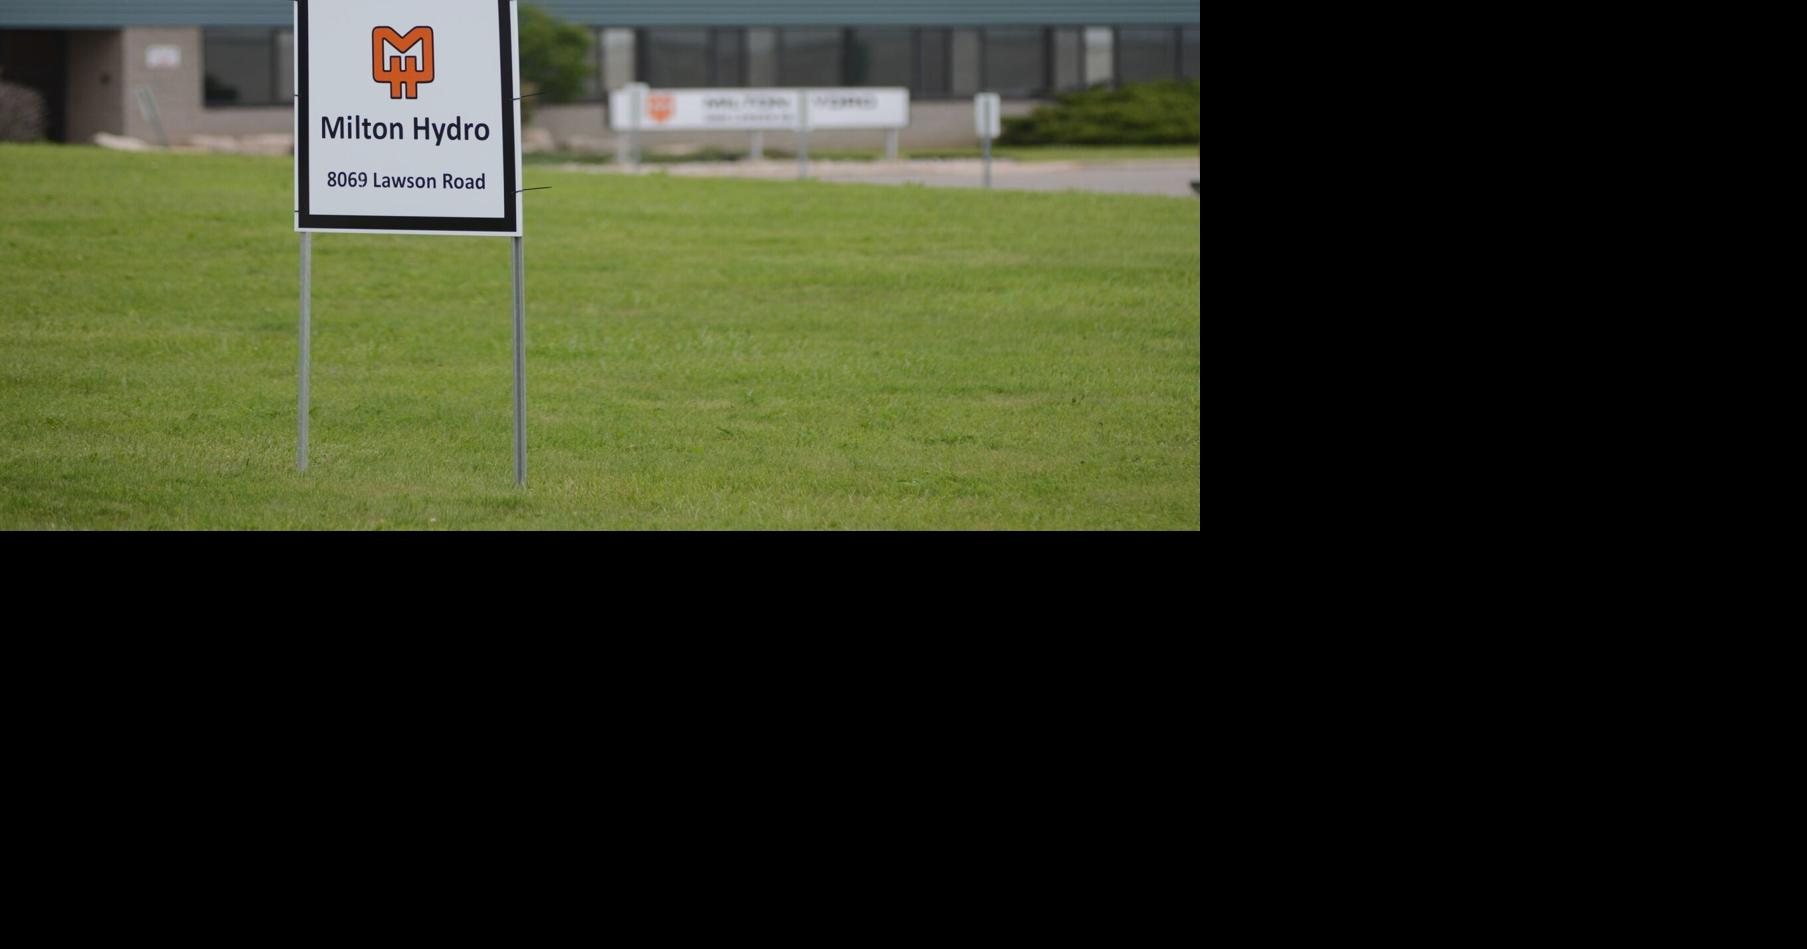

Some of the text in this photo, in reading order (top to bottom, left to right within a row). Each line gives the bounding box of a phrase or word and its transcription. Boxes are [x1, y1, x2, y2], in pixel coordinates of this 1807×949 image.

[321, 115, 490, 146] Milton Hydro
[327, 172, 486, 190] 8069 Lawson Road
